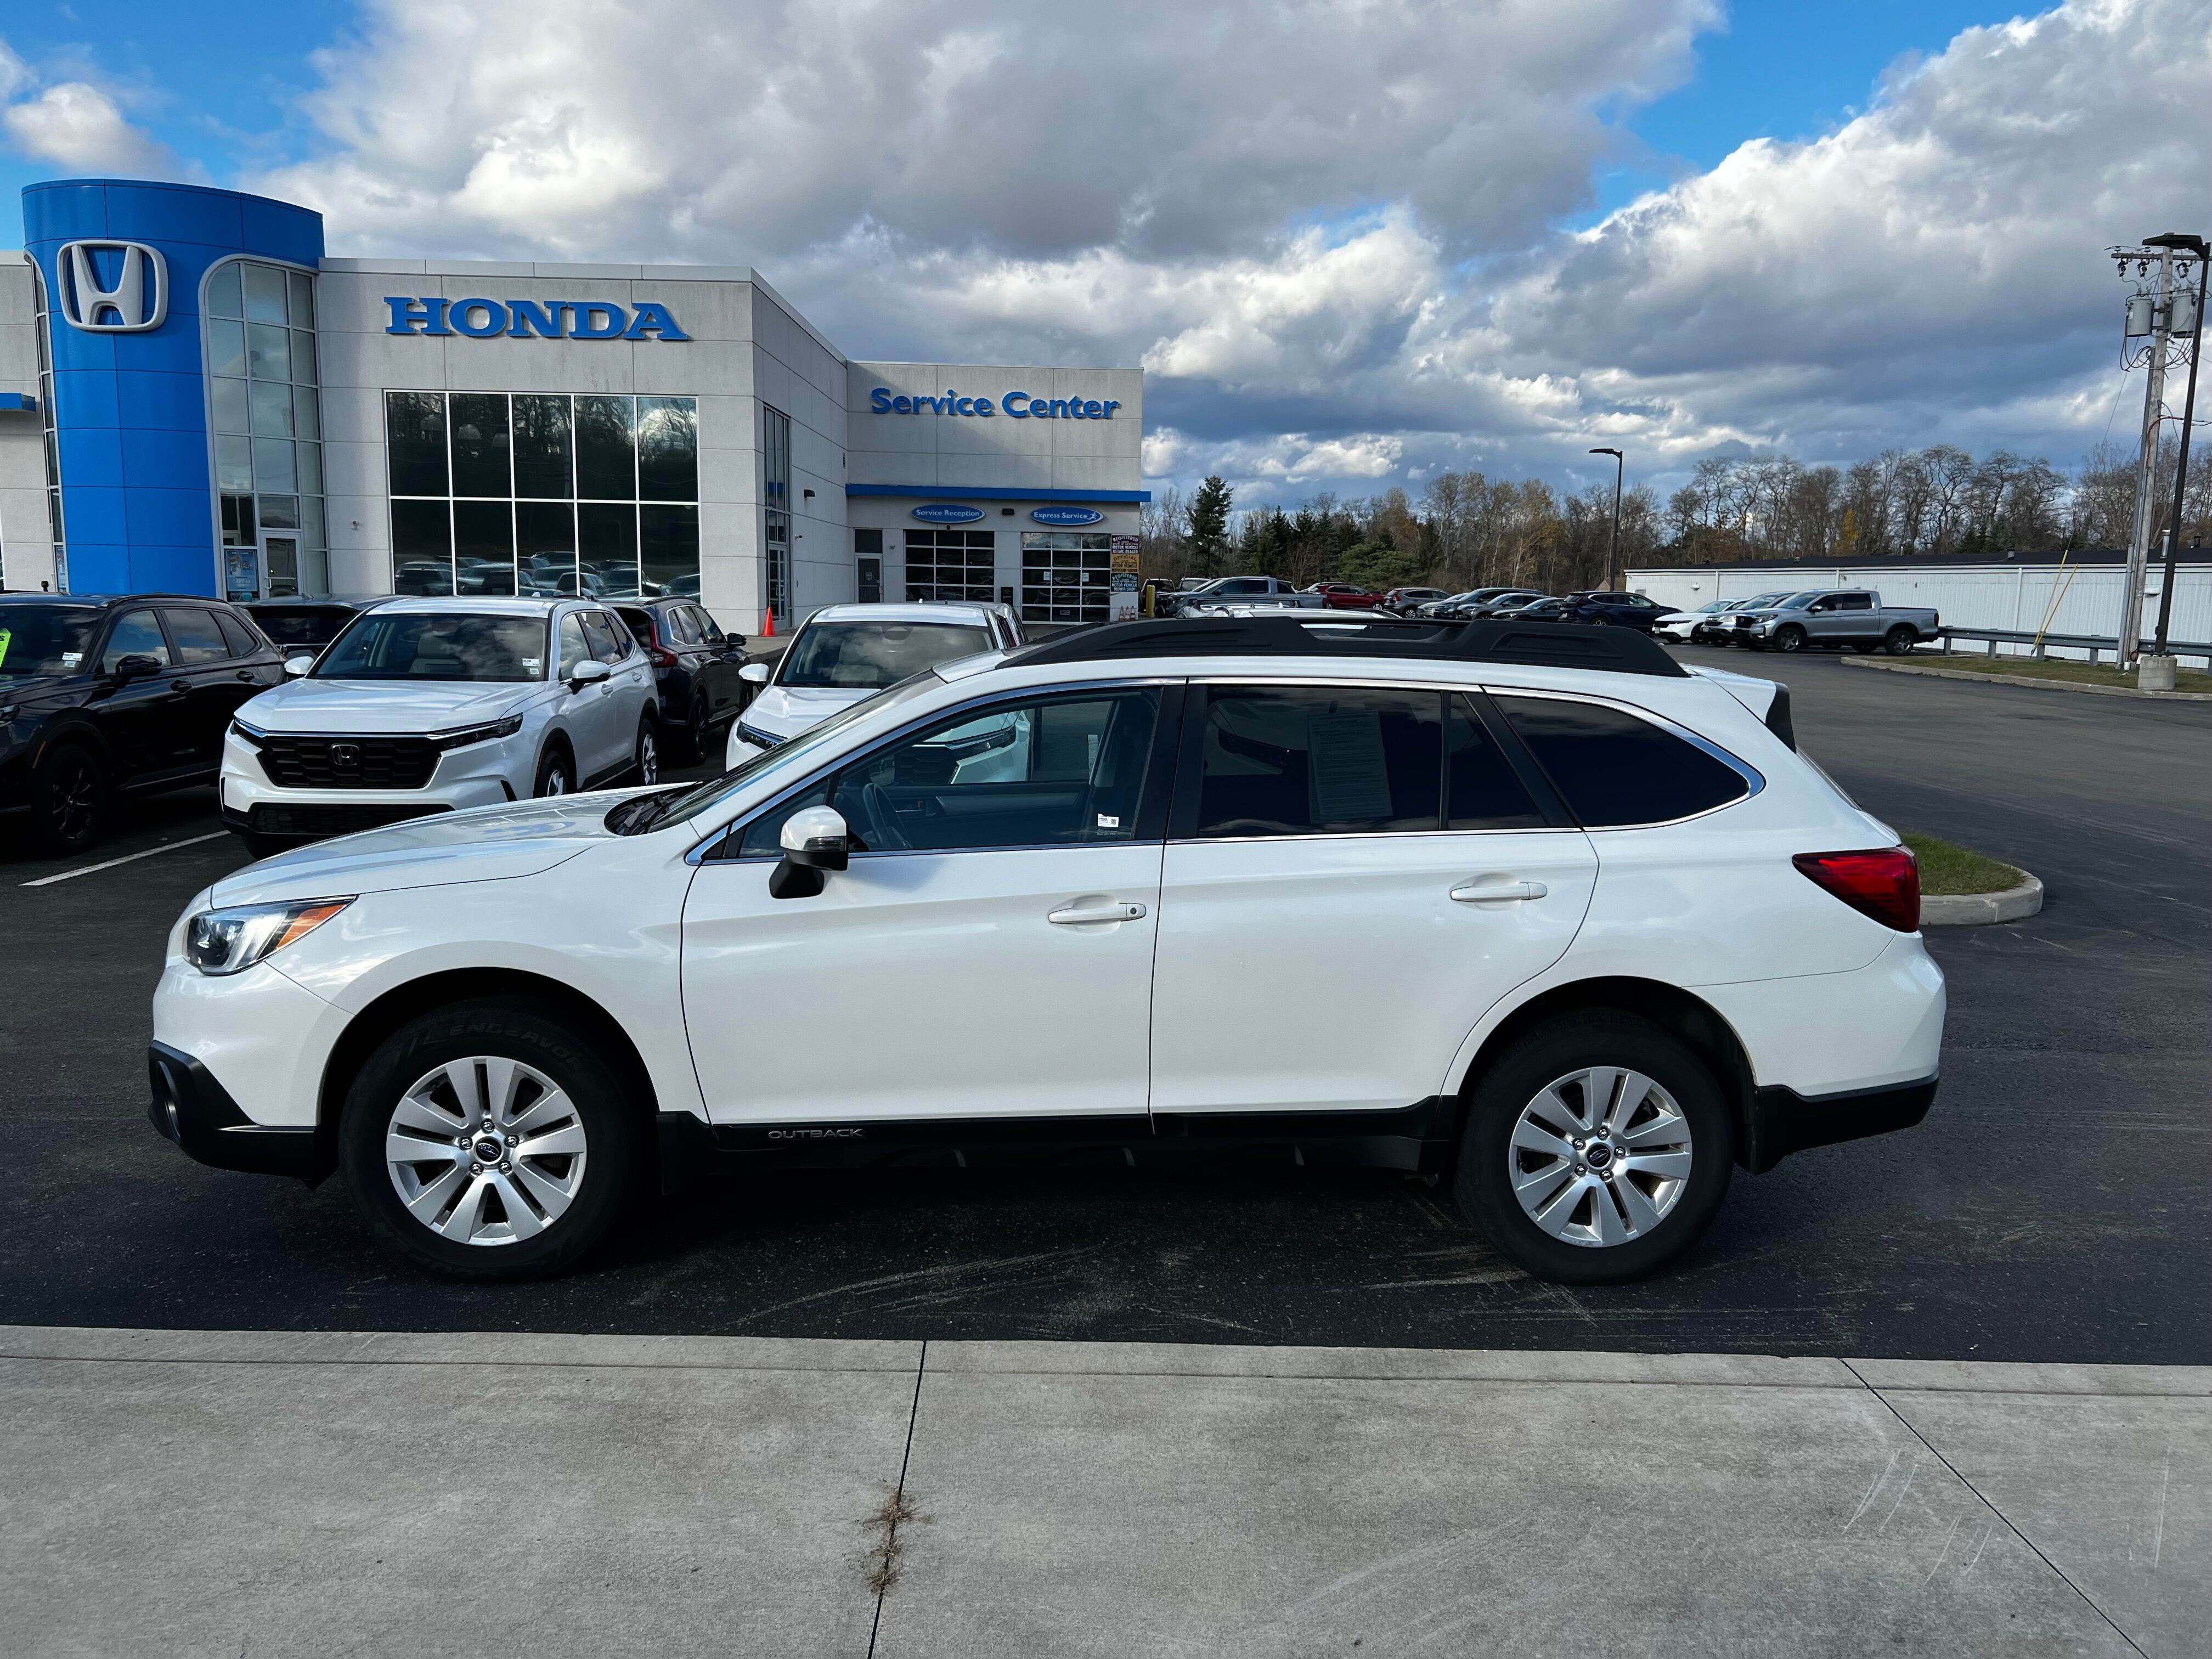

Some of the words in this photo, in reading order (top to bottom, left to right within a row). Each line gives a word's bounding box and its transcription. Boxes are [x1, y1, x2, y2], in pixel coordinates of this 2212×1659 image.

[384, 297, 689, 340] HONDA
[871, 387, 992, 417] Service
[1002, 391, 1120, 419] Center
[944, 510, 980, 518] Reception
[1034, 511, 1060, 520] Express
[768, 1128, 863, 1139] OUTBACK
